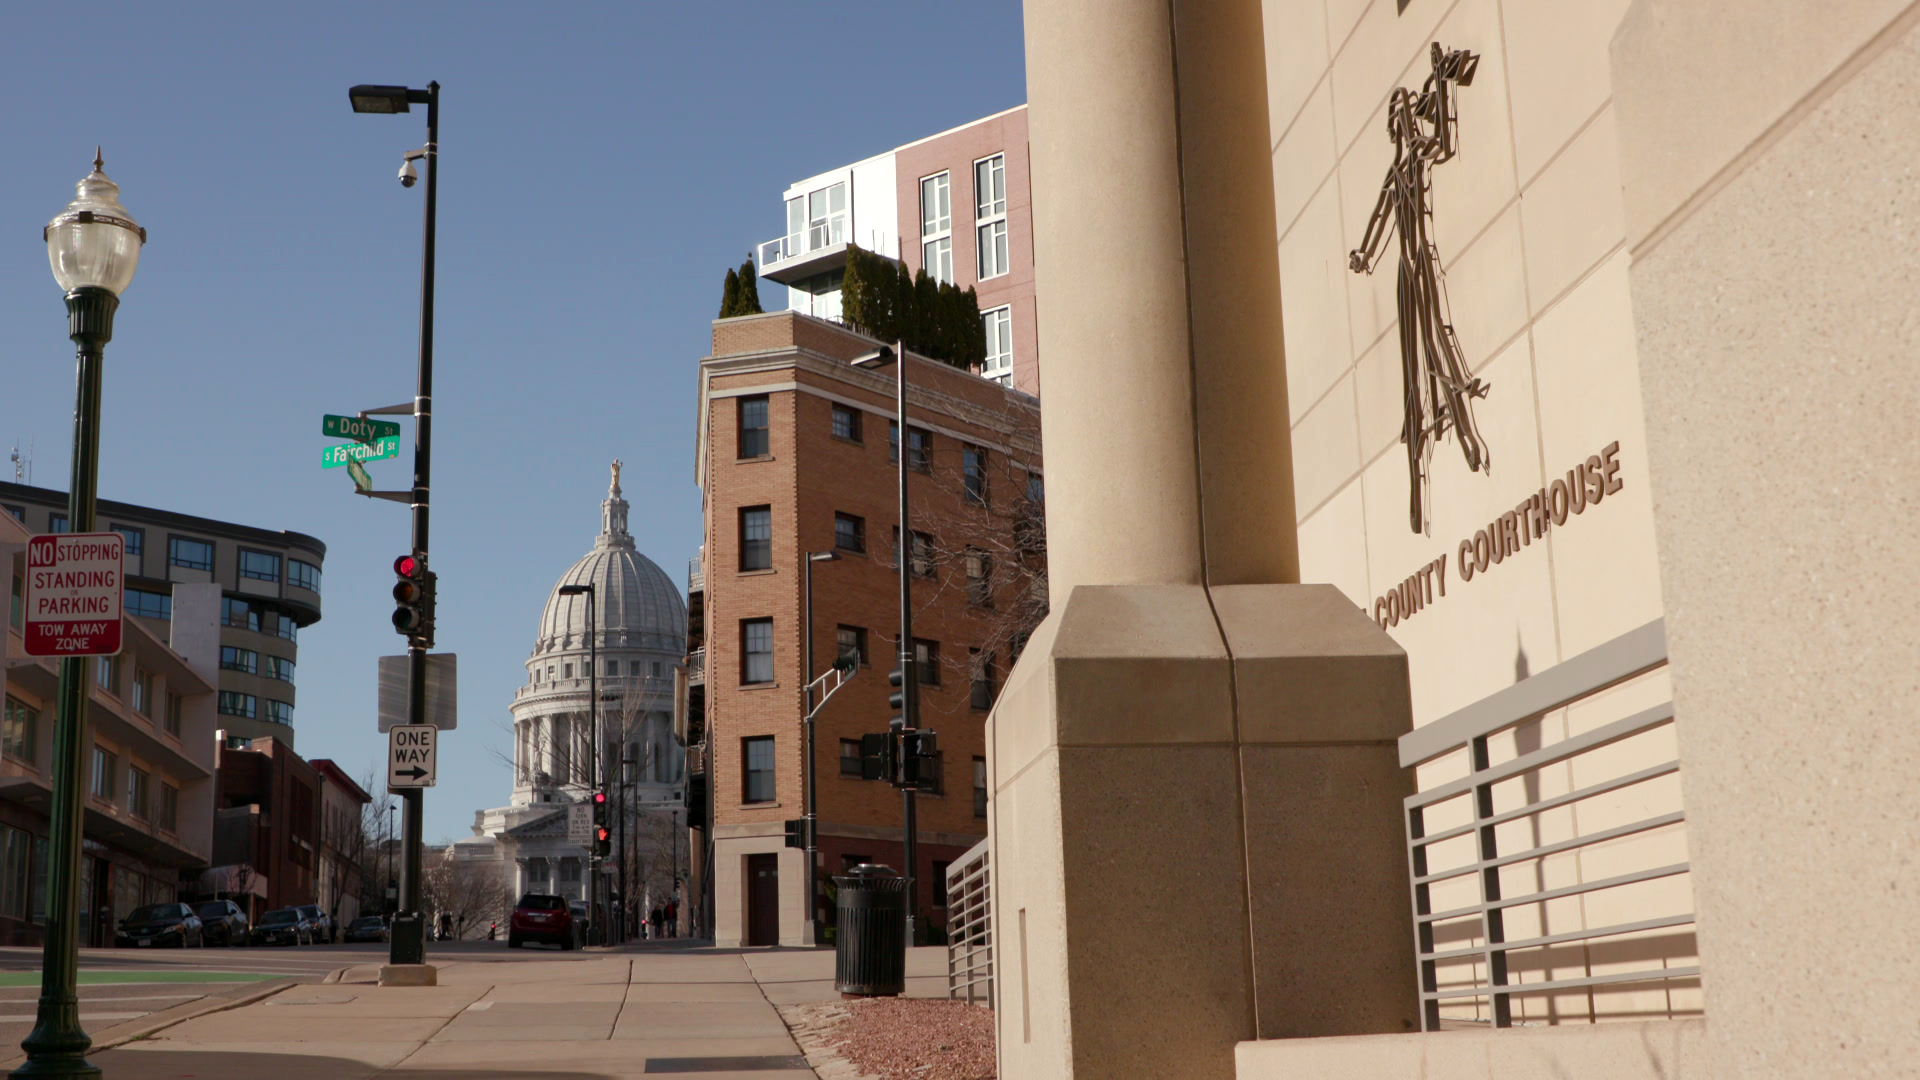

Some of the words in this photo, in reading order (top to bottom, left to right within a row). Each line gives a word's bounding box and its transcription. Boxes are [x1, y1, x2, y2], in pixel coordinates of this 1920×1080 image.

[328, 420, 334, 428] W
[340, 418, 376, 440] Doty
[384, 426, 394, 436] St
[326, 452, 330, 460] S
[334, 440, 384, 463] Fairchild
[387, 441, 396, 451] St
[1374, 553, 1447, 632] COUNTY
[1458, 440, 1624, 582] COURTHOUSE
[30, 542, 55, 565] NO
[57, 543, 119, 561] STOPPING
[35, 570, 115, 589] STANDING
[38, 596, 109, 615] PARKING
[38, 624, 65, 636] TOW
[70, 623, 108, 636] AWAY
[55, 637, 90, 651] ZONE
[396, 731, 430, 746] ONE
[395, 748, 430, 763] WAY
